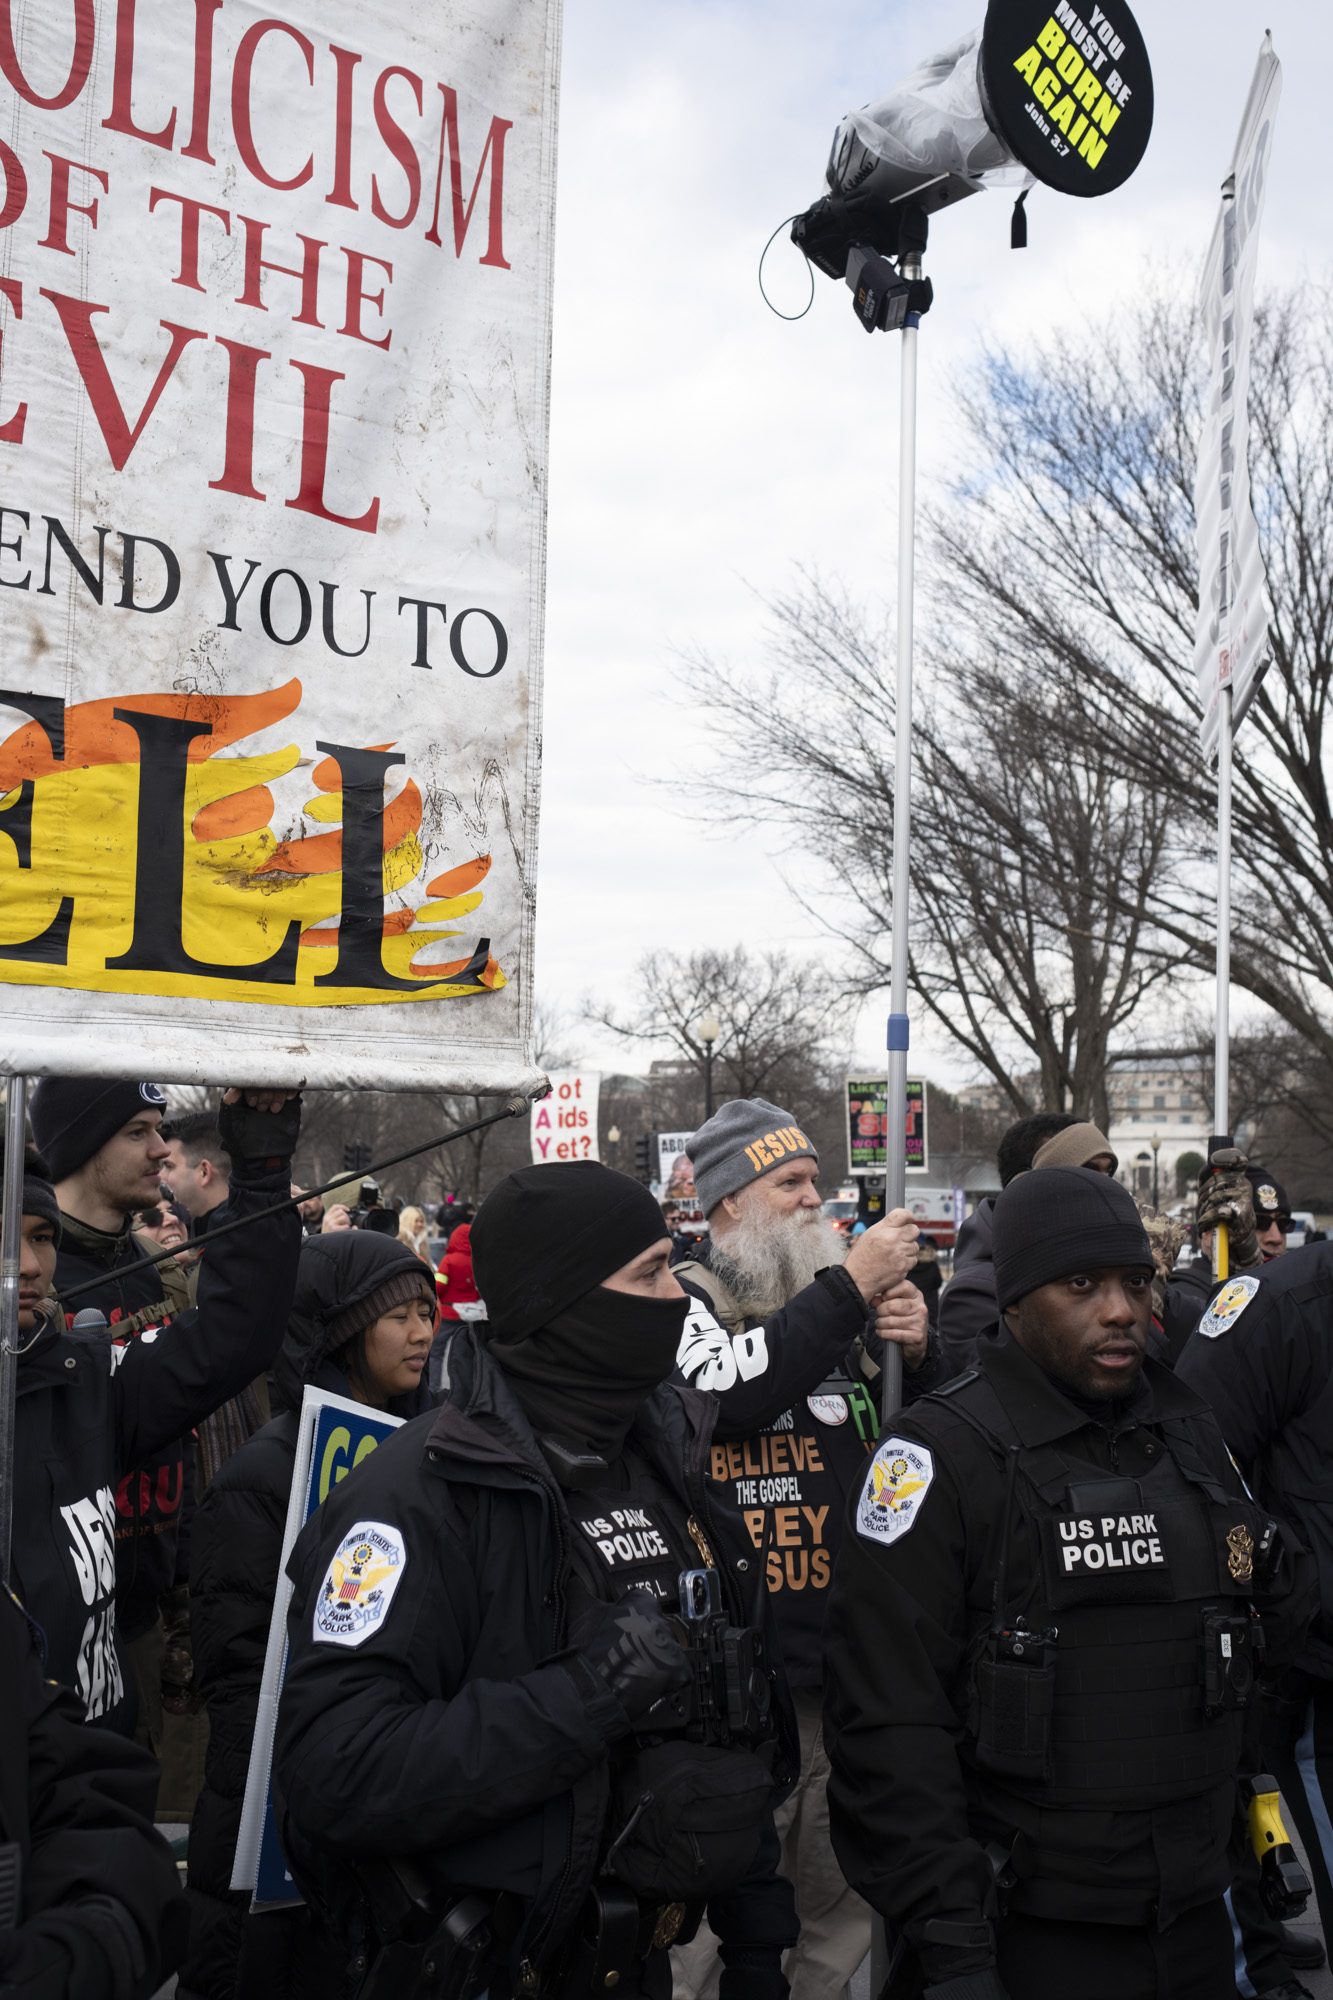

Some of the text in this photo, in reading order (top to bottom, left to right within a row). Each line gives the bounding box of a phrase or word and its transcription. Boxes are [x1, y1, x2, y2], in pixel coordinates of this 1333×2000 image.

[1089, 3, 1126, 61] YOU
[1054, 0, 1132, 108] MUST BE
[1036, 16, 1122, 137] BORN
[1013, 44, 1109, 170] AGAIN
[1024, 101, 1070, 157] John 3:7
[149, 186, 394, 351] THE
[206, 550, 377, 657] YOU
[398, 596, 509, 678] TO
[850, 1084, 876, 1094] LIKE
[558, 1106, 588, 1128] ids
[850, 1099, 922, 1114] PARE
[556, 1136, 591, 1159] et?
[744, 1126, 808, 1172] JESUS
[852, 1139, 880, 1149] WOE
[812, 1398, 845, 1411] PORN
[710, 1434, 825, 1482] BELIEVE
[886, 1449, 924, 1470] UNITED STATES
[736, 1476, 802, 1505] THE GOSPEL
[581, 1508, 653, 1539] US PARK
[864, 1516, 890, 1532] POLICE
[870, 1511, 888, 1523] PARK
[1058, 1514, 1158, 1541] US PARK
[347, 1532, 391, 1551] UNITED STATES
[597, 1530, 669, 1565] POLICE
[1063, 1538, 1164, 1571] POLICE
[321, 1619, 355, 1633] POLICE
[328, 1611, 352, 1622] PARK
